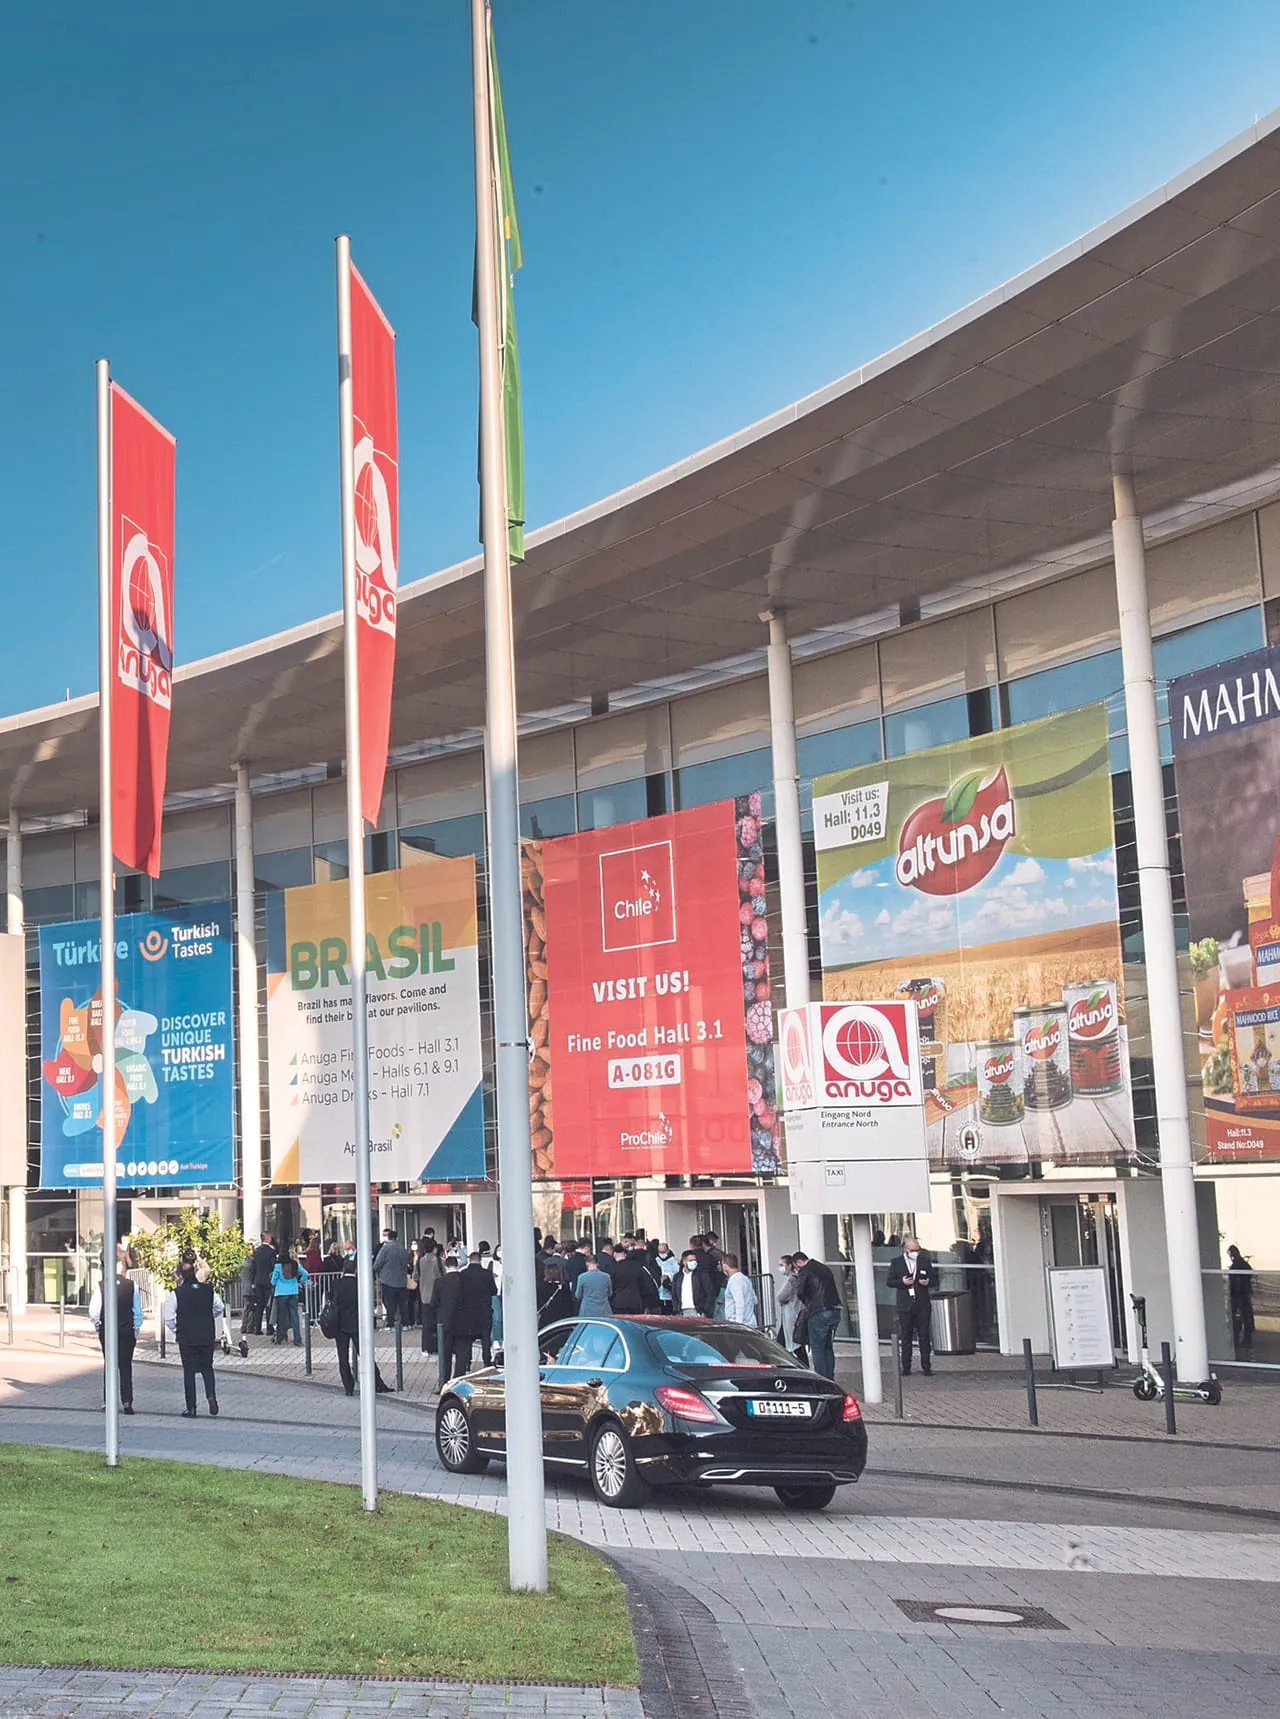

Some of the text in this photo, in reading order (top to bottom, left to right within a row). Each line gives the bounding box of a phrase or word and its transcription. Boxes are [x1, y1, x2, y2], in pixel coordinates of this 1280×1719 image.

[841, 787, 880, 806] Visit us:
[824, 803, 881, 828] Hall: 11.3
[851, 821, 882, 841] D049
[897, 799, 1015, 885] altunsa
[614, 897, 653, 920] Chile
[171, 921, 220, 942] Turkish
[52, 937, 129, 967] Türkie
[172, 941, 213, 959] Tastes
[297, 997, 321, 1011] Brazil
[323, 997, 338, 1008] has
[400, 987, 425, 1000] Come
[429, 983, 447, 996] and
[592, 970, 690, 1003] VISIT US!
[161, 1011, 226, 1032] DISCOVER
[306, 1013, 323, 1025] find
[325, 1010, 345, 1023] their
[368, 1008, 378, 1018] at
[379, 1007, 395, 1018] our
[397, 1000, 441, 1016] pavilions.
[1069, 1003, 1114, 1032] altunsa
[161, 1028, 212, 1048] UNIQUE
[567, 1018, 724, 1053] Fine Food Hall 3.1
[1024, 1030, 1061, 1055] altunsa
[161, 1043, 225, 1065] TURKISH
[301, 1051, 337, 1067] Anuga
[368, 1043, 405, 1060] Foods
[418, 1039, 441, 1055] Hall
[444, 1037, 459, 1052] 3.1
[161, 1062, 215, 1083] TASTES
[301, 1072, 338, 1087] Anuga
[382, 1064, 410, 1079] Halls
[413, 1061, 428, 1077] 6.1
[431, 1060, 441, 1075] &
[443, 1058, 459, 1074] 9.1
[612, 1060, 676, 1083] A-081G
[302, 1092, 338, 1106] Anuga
[391, 1083, 413, 1098] Hall
[417, 1082, 430, 1097] 7.1
[825, 1080, 912, 1103] anuga
[821, 1110, 872, 1120] Eingang Nord
[821, 1119, 879, 1129] Entrance North
[620, 1131, 668, 1146] ProChile
[1217, 1140, 1236, 1150] Stand
[826, 1169, 844, 1177] TAXI
